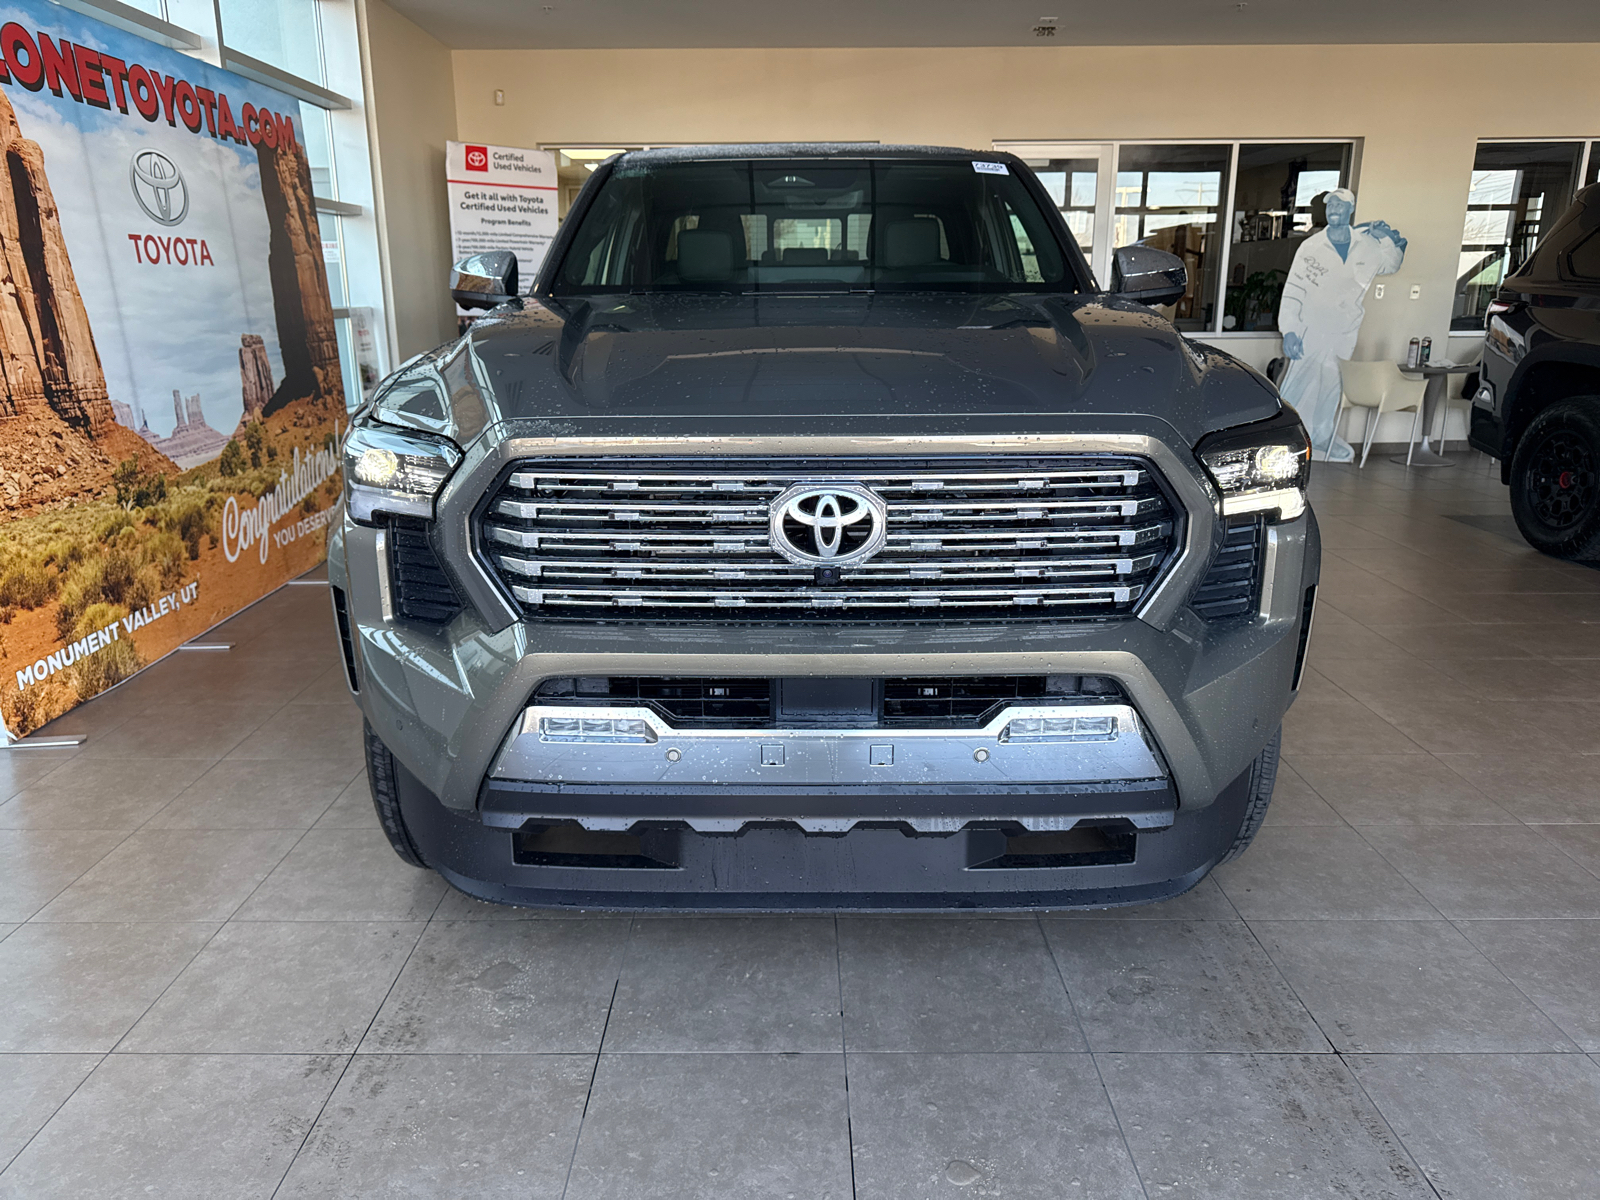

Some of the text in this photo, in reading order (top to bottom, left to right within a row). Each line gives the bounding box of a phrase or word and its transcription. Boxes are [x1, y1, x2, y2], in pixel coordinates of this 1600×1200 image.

[0, 22, 298, 152] ONETOYOTA.COM
[493, 152, 524, 163] Certified
[494, 162, 542, 173] Used Vehicles
[464, 191, 544, 205] Get it all with Toyota
[460, 202, 549, 215] Certified Used Vehicles
[481, 217, 532, 227] Program Benefits
[128, 234, 215, 267] TOYOTA
[222, 418, 341, 564] Congratulations!
[273, 526, 296, 549] YOU
[15, 581, 198, 692] MONUMENT VALLEY, UT
